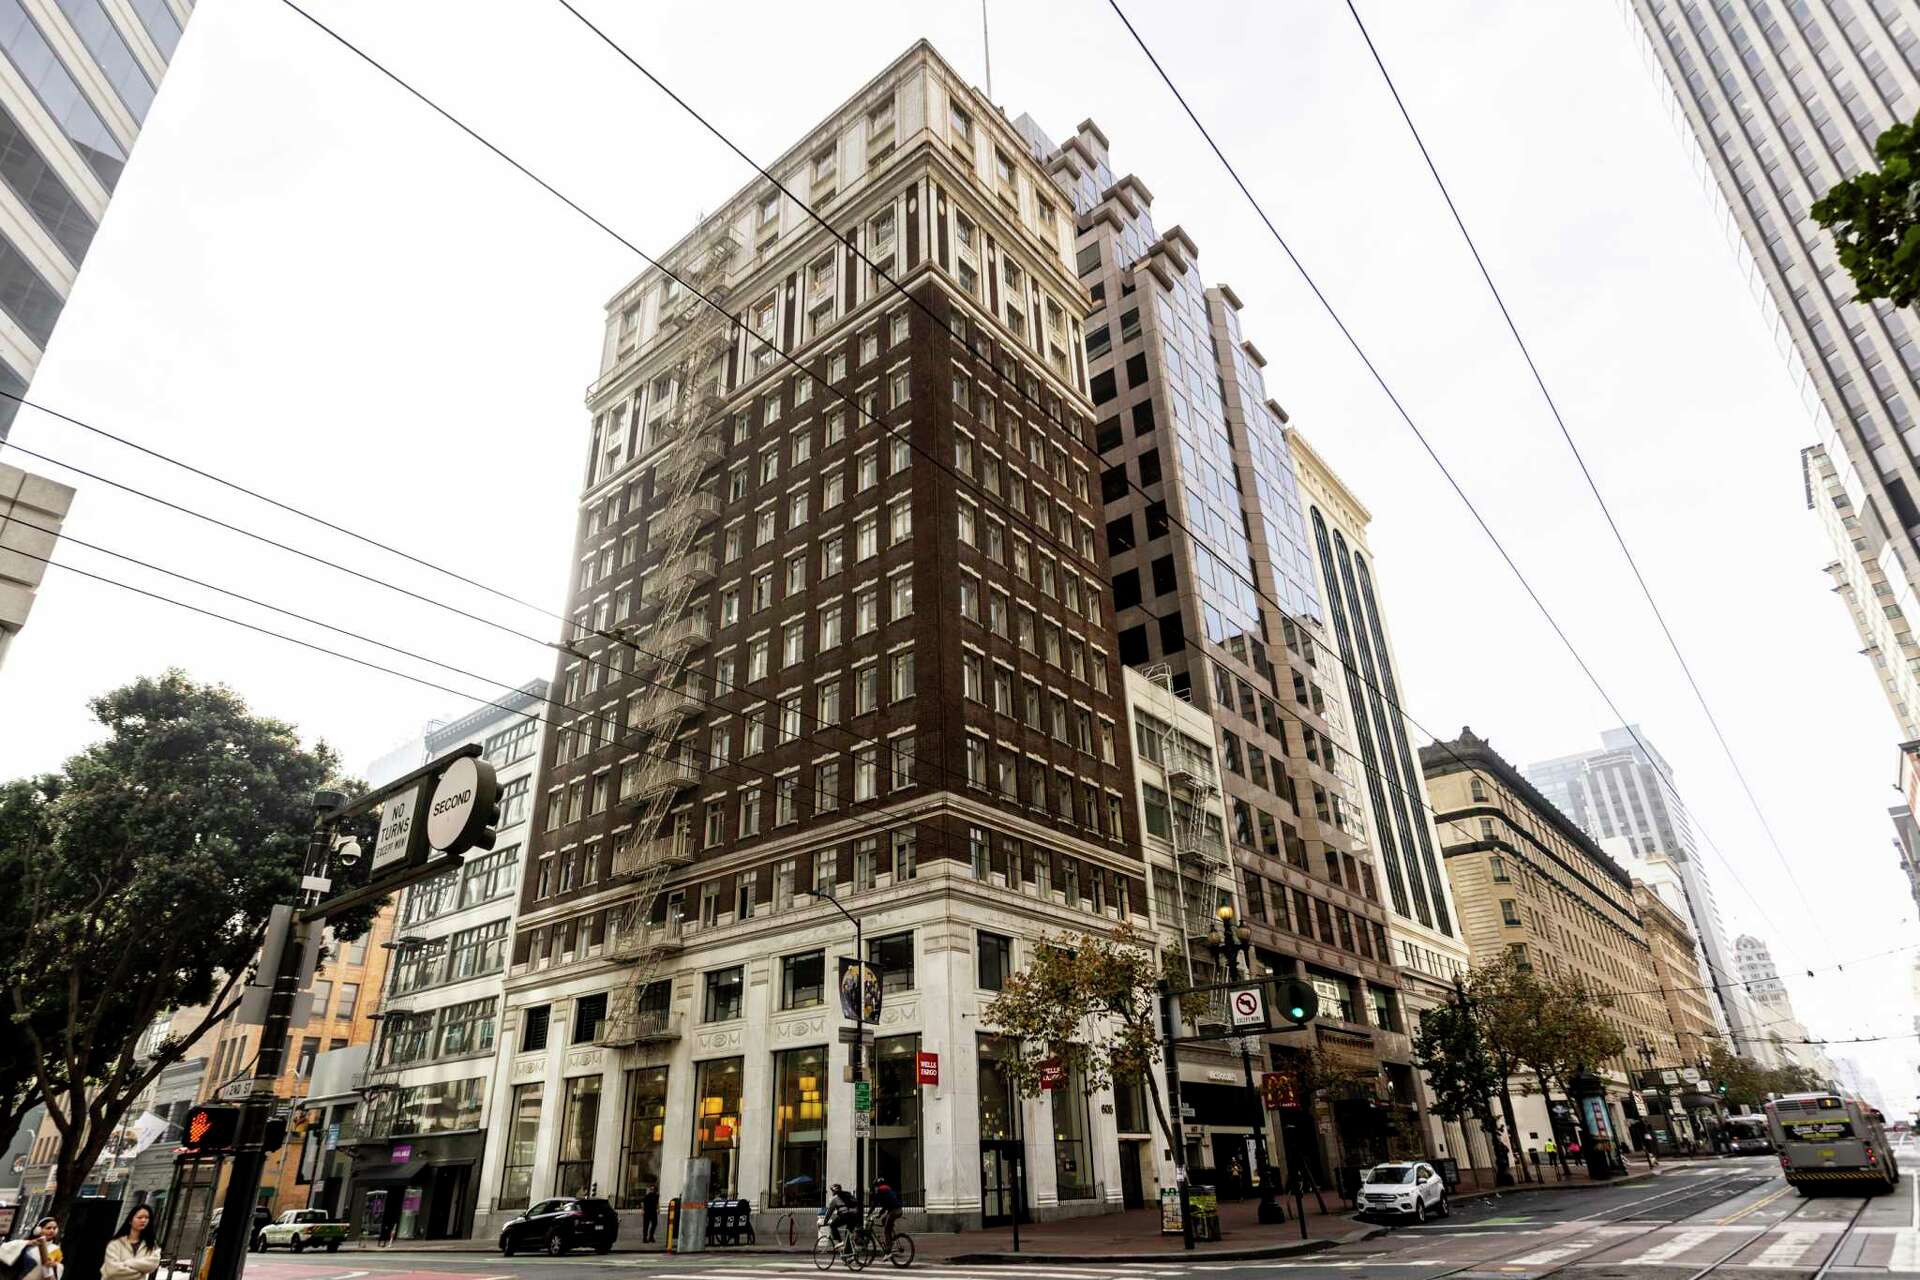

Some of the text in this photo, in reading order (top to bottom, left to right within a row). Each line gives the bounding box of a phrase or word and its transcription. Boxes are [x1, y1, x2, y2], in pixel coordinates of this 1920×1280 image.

[392, 803, 405, 821] NO
[433, 789, 471, 817] SECOND
[381, 817, 410, 843] TURNS
[920, 1061, 937, 1069] WELLS
[1101, 1104, 1113, 1115] 605
